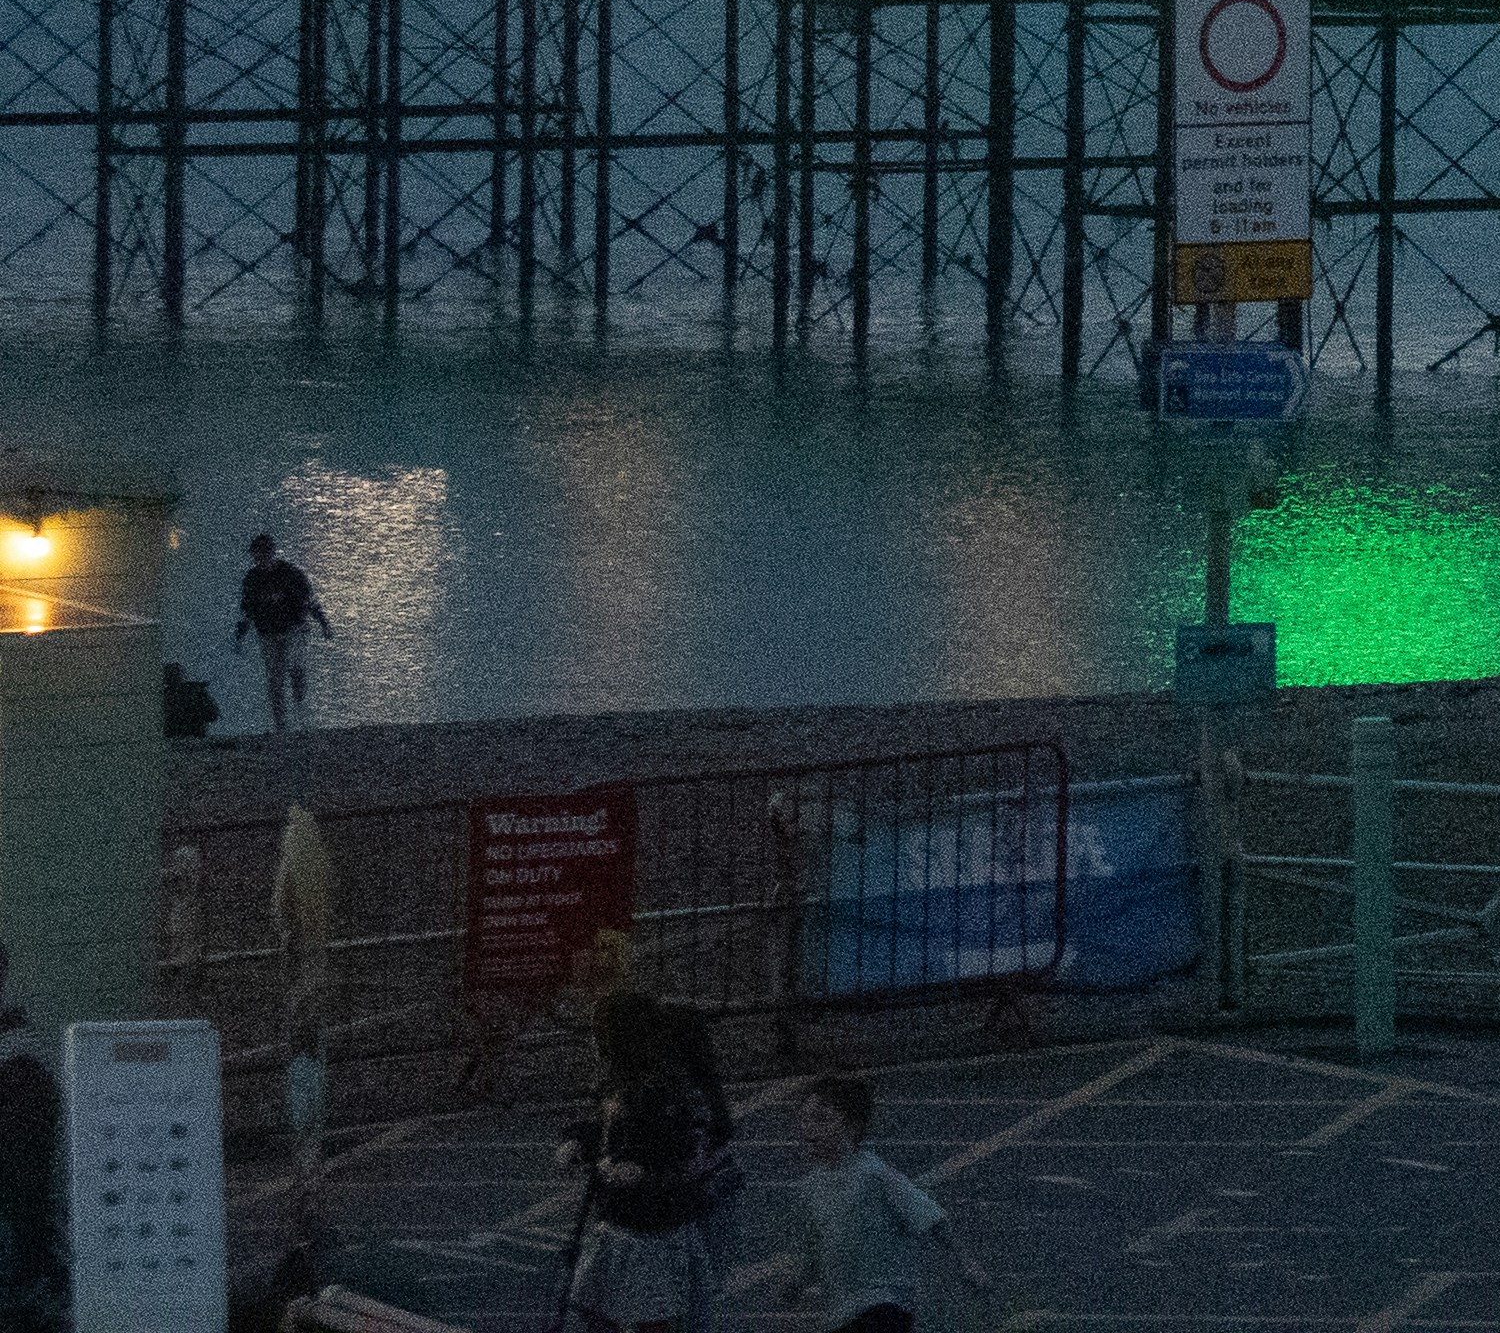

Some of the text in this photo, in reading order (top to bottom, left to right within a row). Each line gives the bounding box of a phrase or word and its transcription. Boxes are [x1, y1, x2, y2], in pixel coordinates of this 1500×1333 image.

[485, 808, 609, 836] Warning!
[485, 839, 620, 860] NO LIFEGUARDS
[485, 866, 563, 885] ON DUTY
